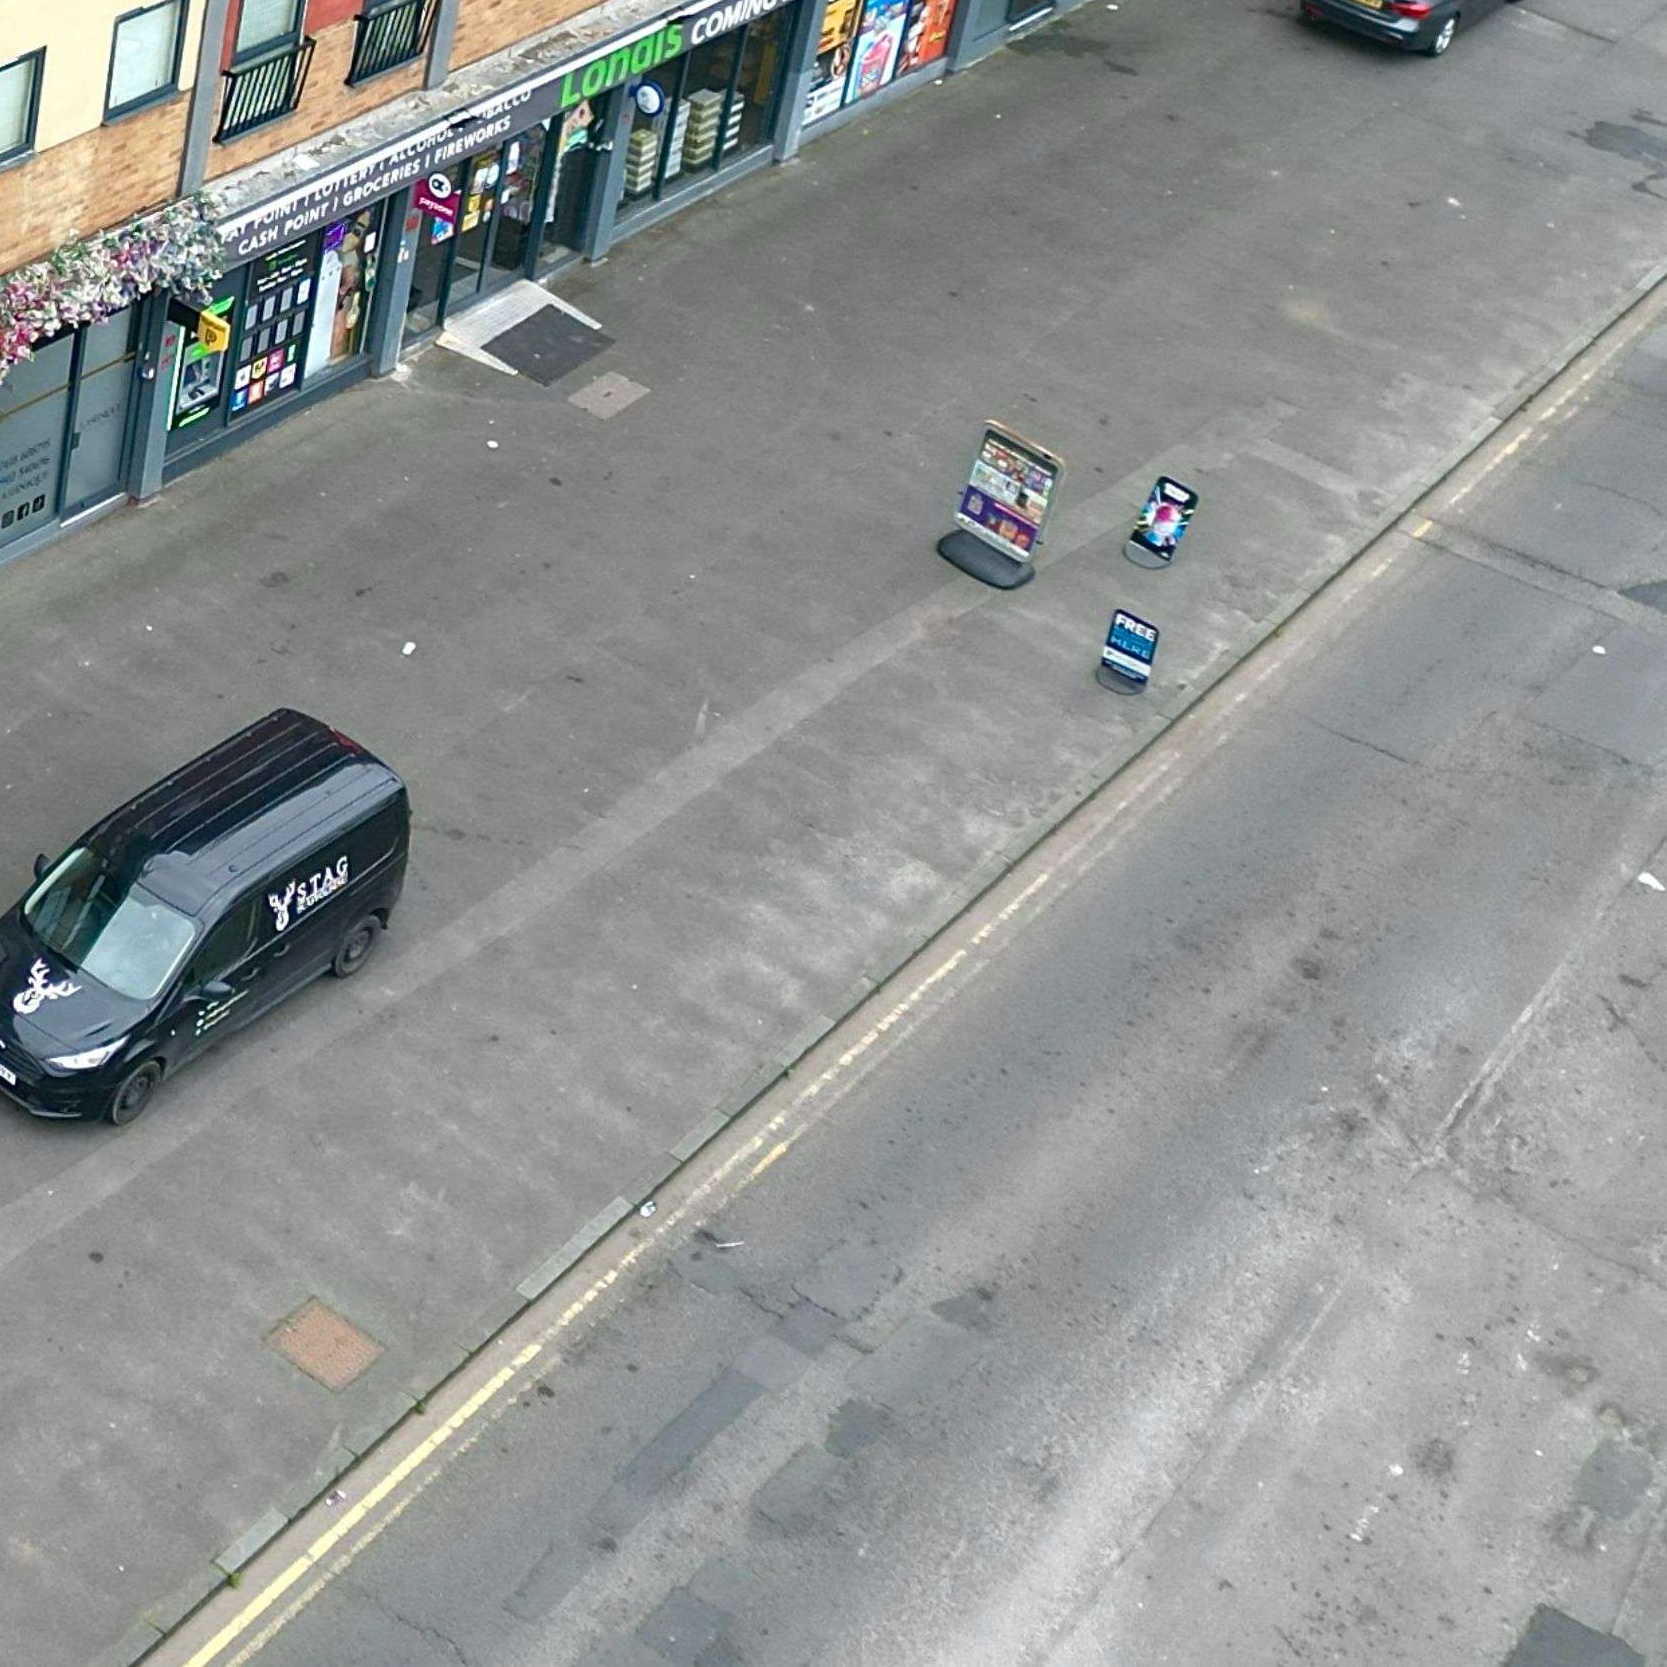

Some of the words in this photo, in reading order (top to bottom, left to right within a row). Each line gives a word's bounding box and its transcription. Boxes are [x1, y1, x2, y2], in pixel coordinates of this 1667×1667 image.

[238, 225, 279, 255] CASH
[284, 202, 329, 237] POINT
[343, 158, 421, 207] GROCERIES
[434, 115, 511, 164] FIREWORKS
[1115, 613, 1157, 643] FREE
[296, 855, 349, 898] STAG
